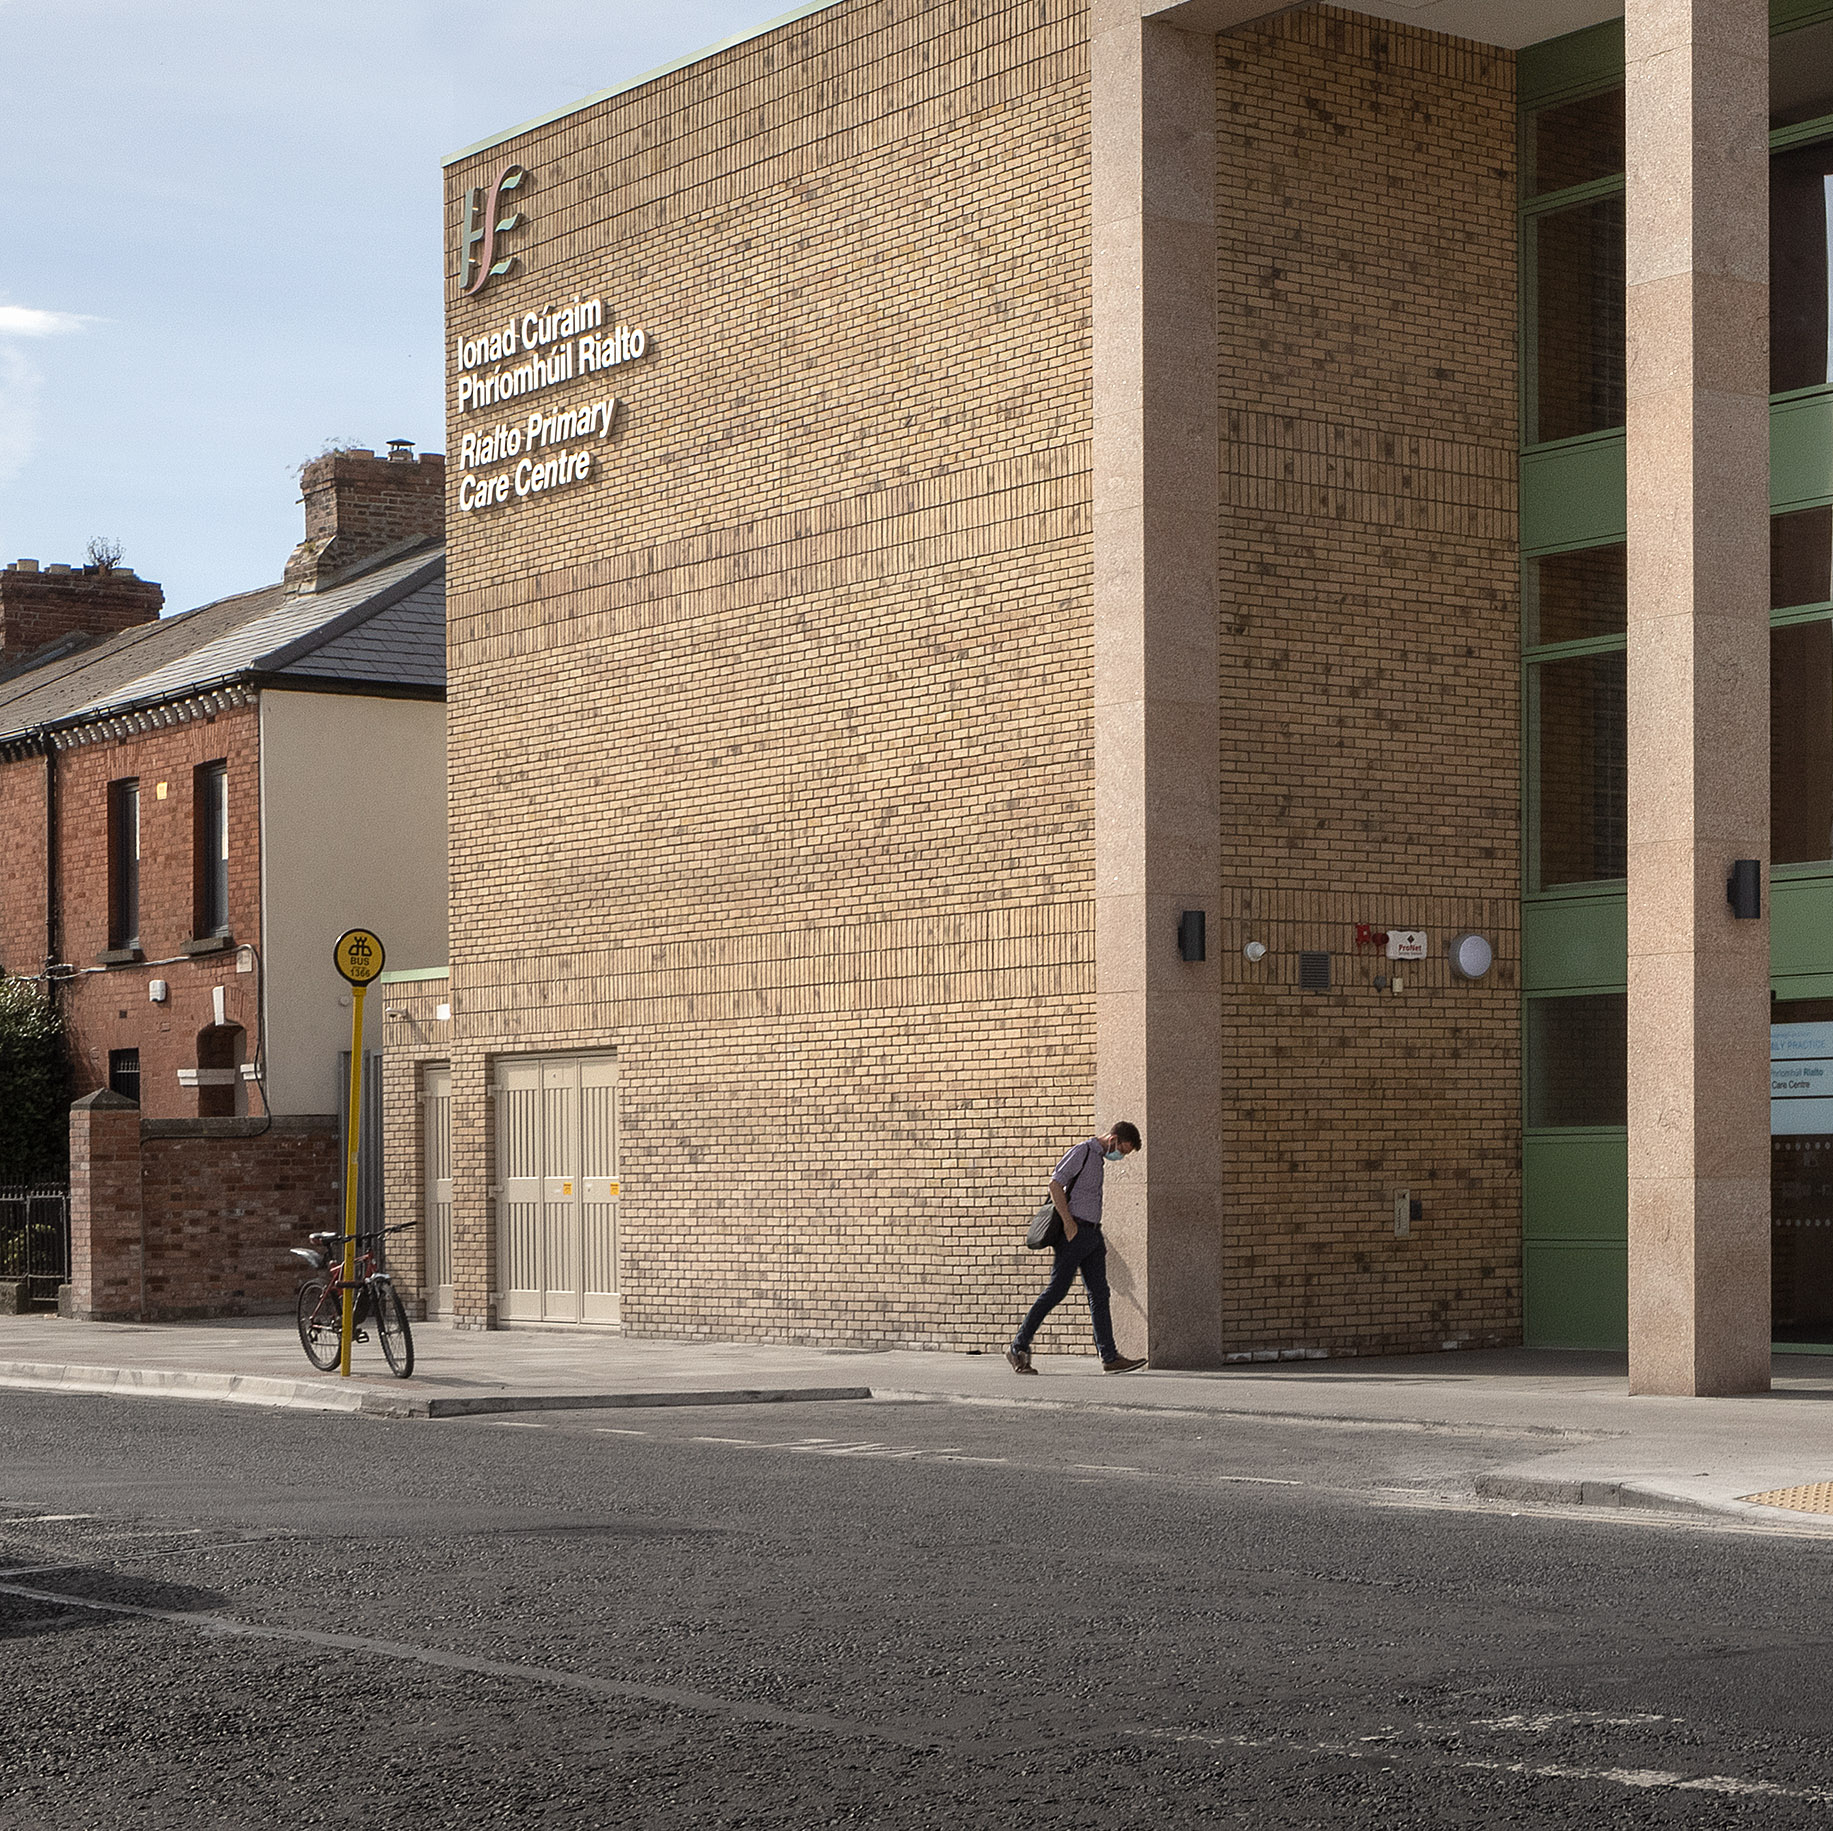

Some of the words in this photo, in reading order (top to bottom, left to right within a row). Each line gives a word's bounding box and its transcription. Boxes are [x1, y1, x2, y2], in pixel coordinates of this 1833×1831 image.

[457, 318, 516, 372] Ionad
[521, 295, 601, 350] Cúraim
[458, 342, 573, 414] Phríomhúil
[578, 324, 646, 376] Rialto
[459, 424, 521, 471] Rialto
[525, 397, 616, 452] Primary
[459, 473, 510, 512] Care
[514, 449, 591, 497] Centre
[350, 957, 370, 966] BUS
[1771, 1081, 1787, 1089] Care
[1788, 1080, 1810, 1089] Centre
